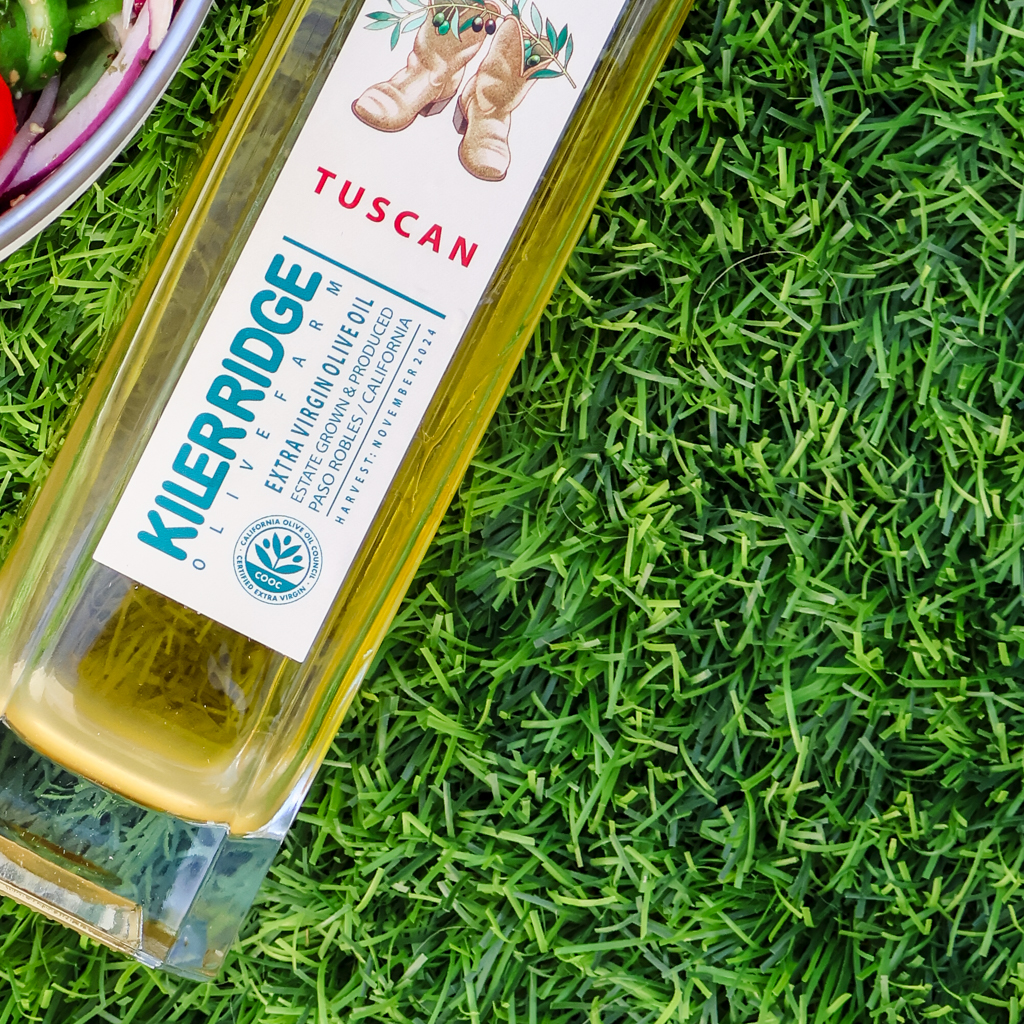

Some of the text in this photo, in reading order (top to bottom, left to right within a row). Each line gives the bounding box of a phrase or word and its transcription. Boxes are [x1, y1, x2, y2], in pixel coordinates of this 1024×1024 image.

[315, 167, 478, 267] TUSCAN
[265, 297, 374, 493] EXTRA VIRGIN OLIVE OIL
[291, 307, 393, 503] ESTATE GROWN & PRODUCED
[309, 473, 334, 512] PASO
[329, 415, 363, 471] ROBLES
[362, 319, 412, 403] CALIFORNIA
[335, 329, 436, 524] HARVEST: NOVEMBER 2024
[237, 555, 306, 601] CERTIFIED EXTRA VIRGIN
[241, 519, 319, 579] CALIFORNIA OLIVE OIL COUNCIL
[255, 571, 282, 589] COOC
